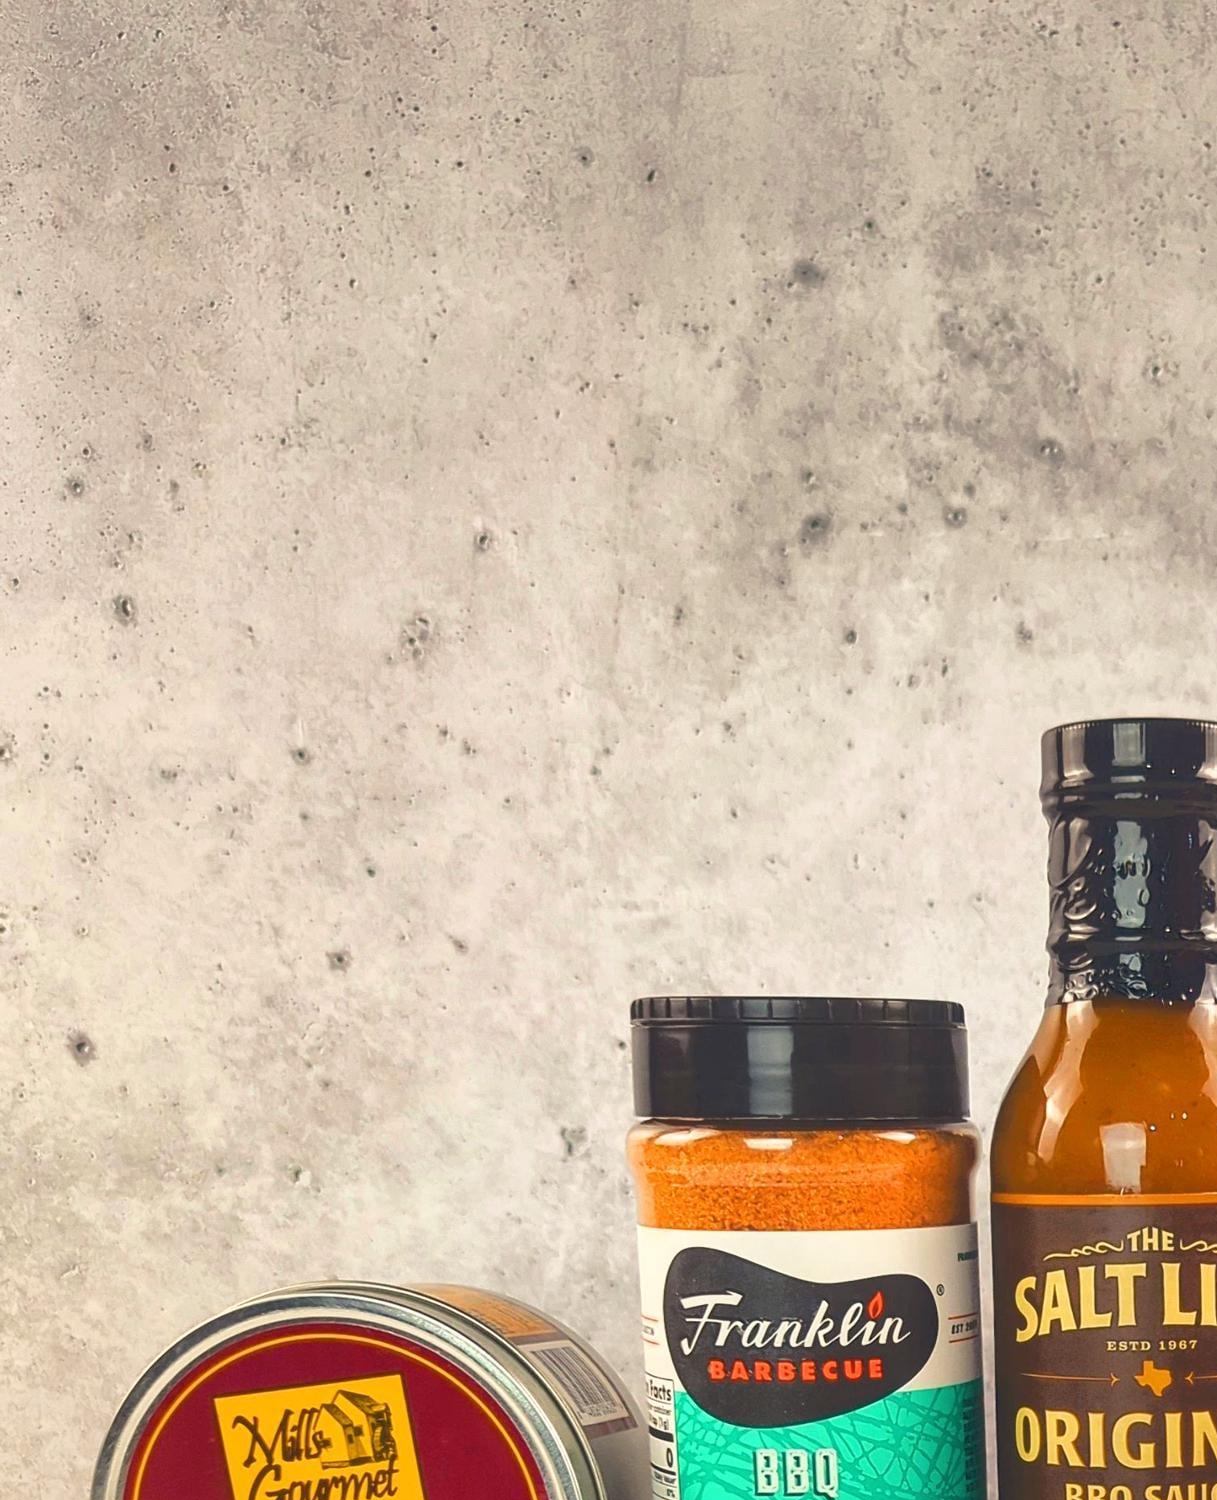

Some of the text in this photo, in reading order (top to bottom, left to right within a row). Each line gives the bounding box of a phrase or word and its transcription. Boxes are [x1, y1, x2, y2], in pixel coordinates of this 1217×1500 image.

[1126, 1226, 1176, 1253] THE
[1014, 1262, 1148, 1344] SALT
[680, 1290, 912, 1360] Franklin
[1105, 1338, 1199, 1352] ESTD 1967
[709, 1359, 884, 1382] BARBECUE
[753, 1448, 839, 1500] BBQ
